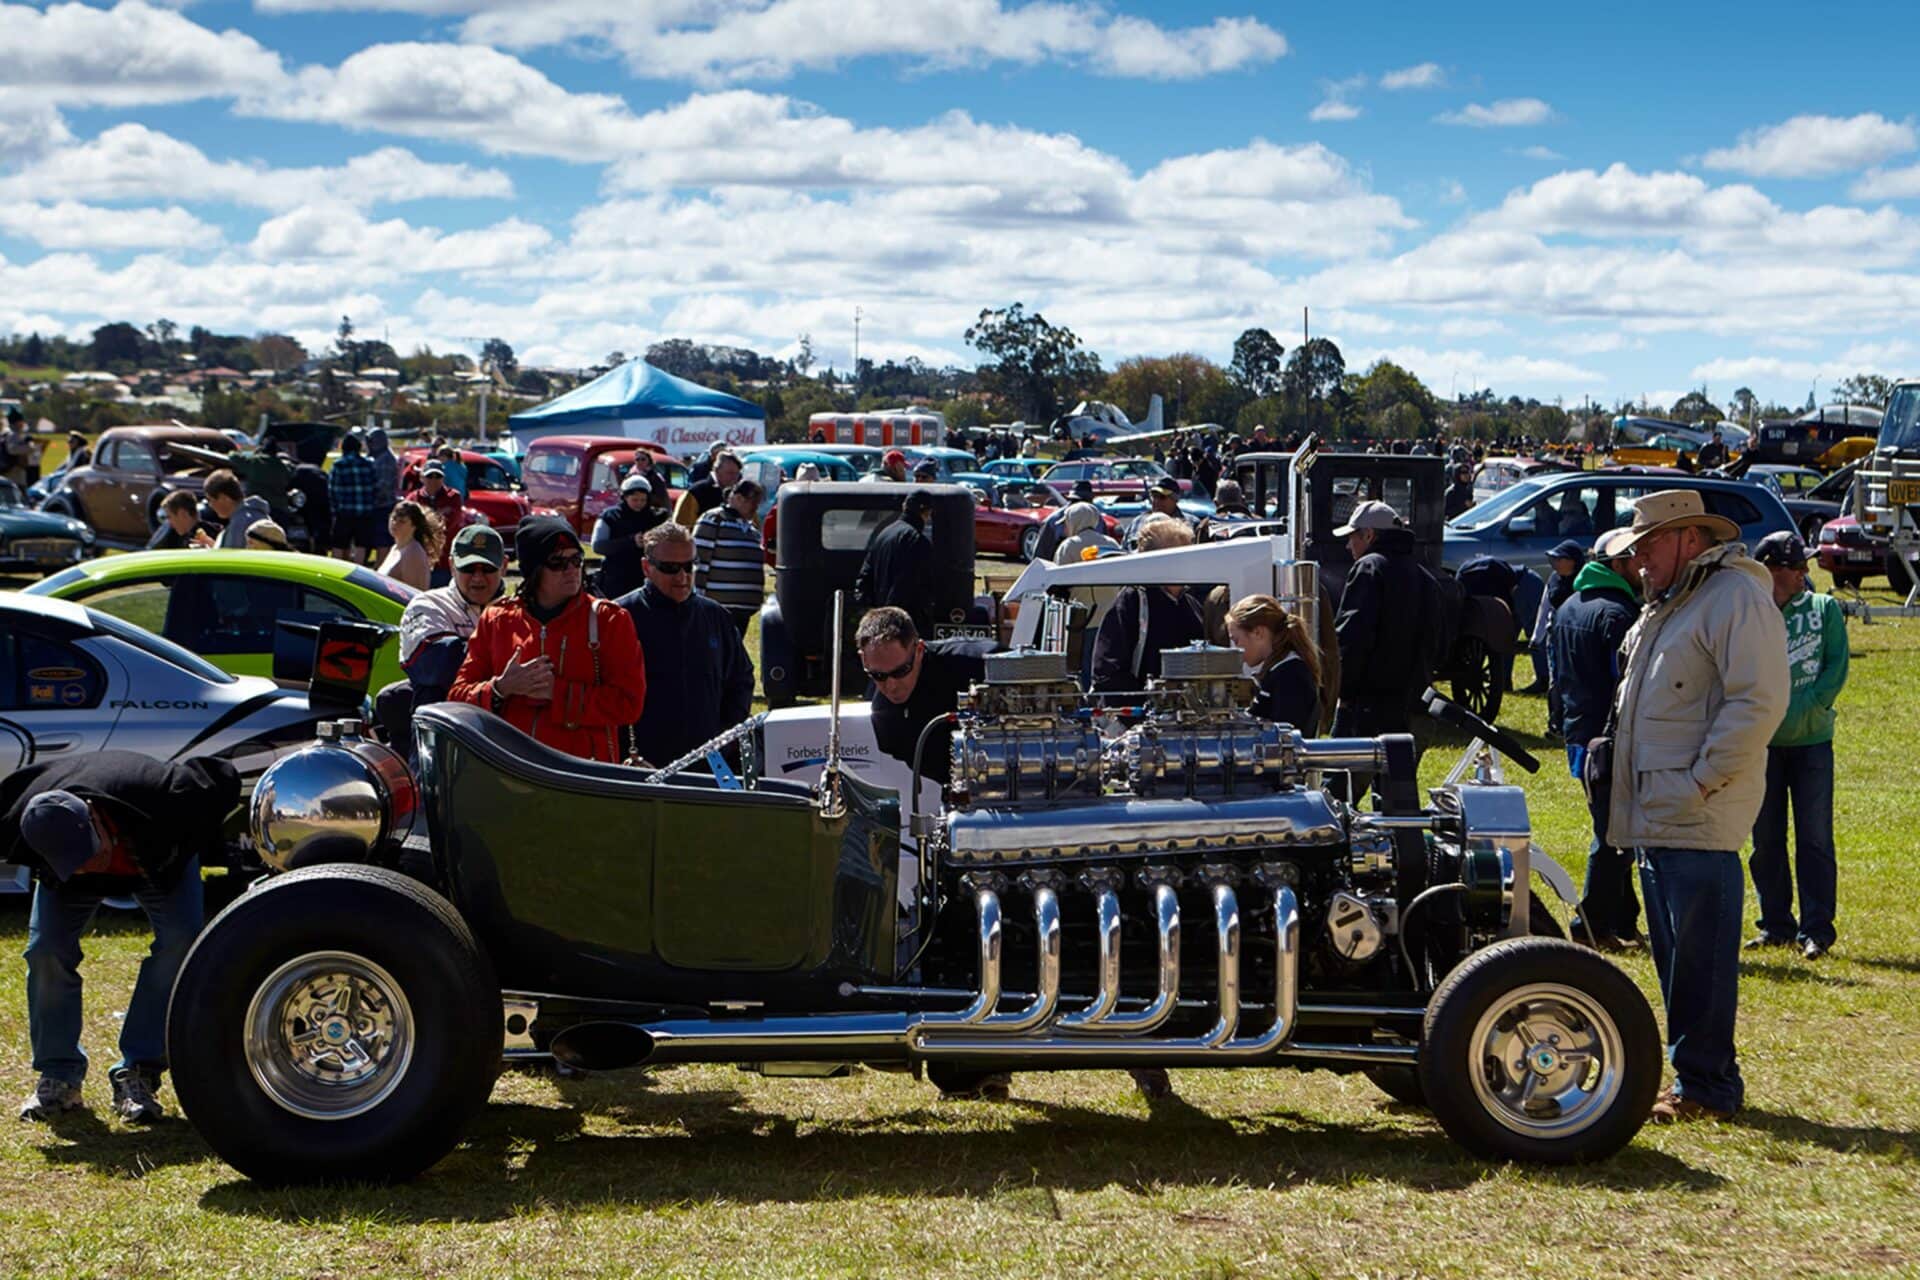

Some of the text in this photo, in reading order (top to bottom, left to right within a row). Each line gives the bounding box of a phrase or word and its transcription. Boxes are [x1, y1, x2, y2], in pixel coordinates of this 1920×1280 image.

[671, 427, 720, 443] Classics
[109, 701, 209, 710] FALCON
[786, 744, 870, 759] Forbes Bteries
